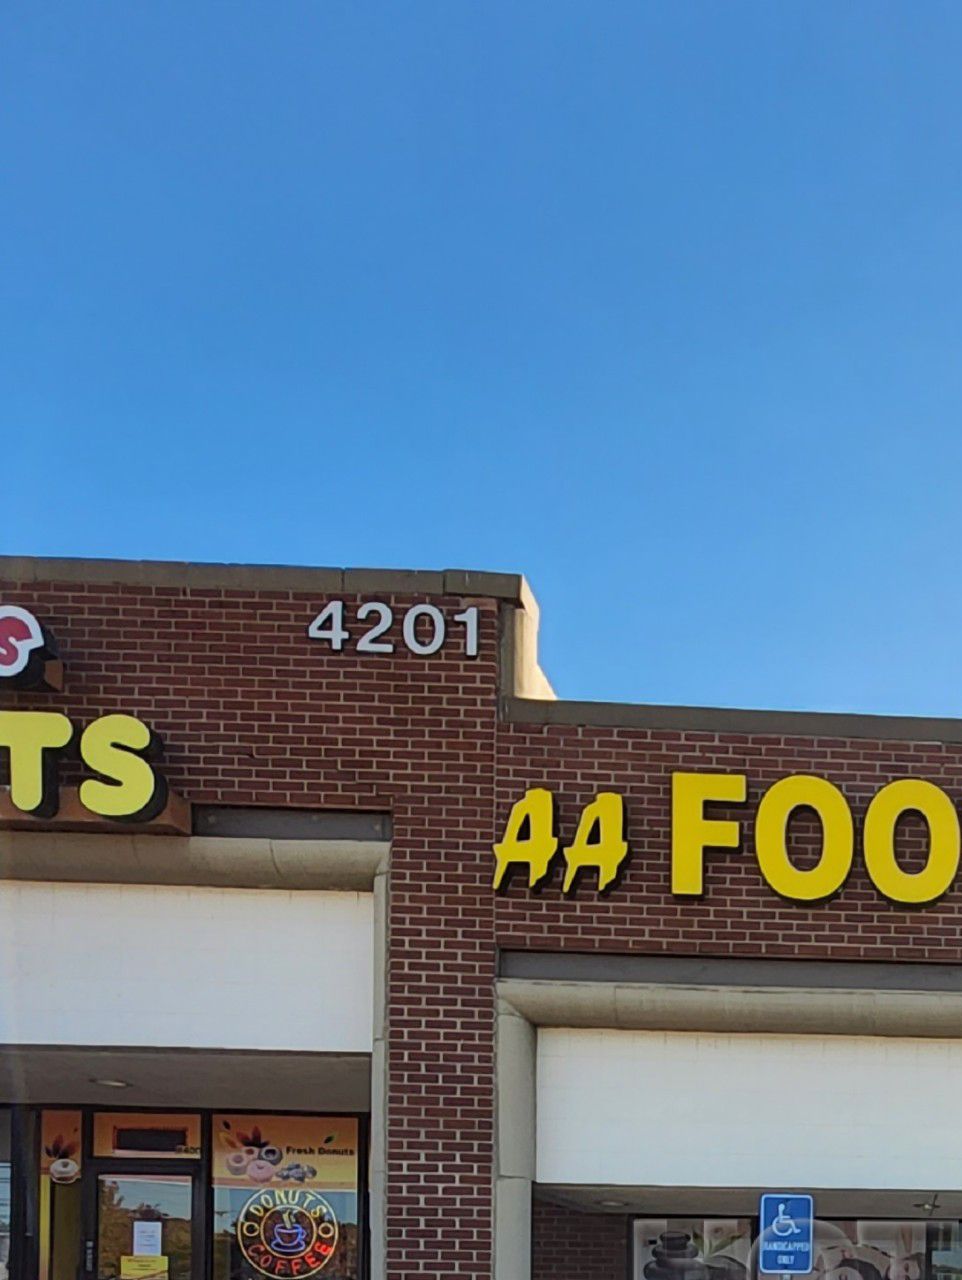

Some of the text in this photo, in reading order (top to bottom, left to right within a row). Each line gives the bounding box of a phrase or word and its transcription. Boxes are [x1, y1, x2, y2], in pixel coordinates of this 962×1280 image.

[308, 600, 481, 657] 4201
[493, 788, 628, 892] AA
[250, 1189, 328, 1218] DONUTS
[247, 1242, 334, 1276] COFFEE
